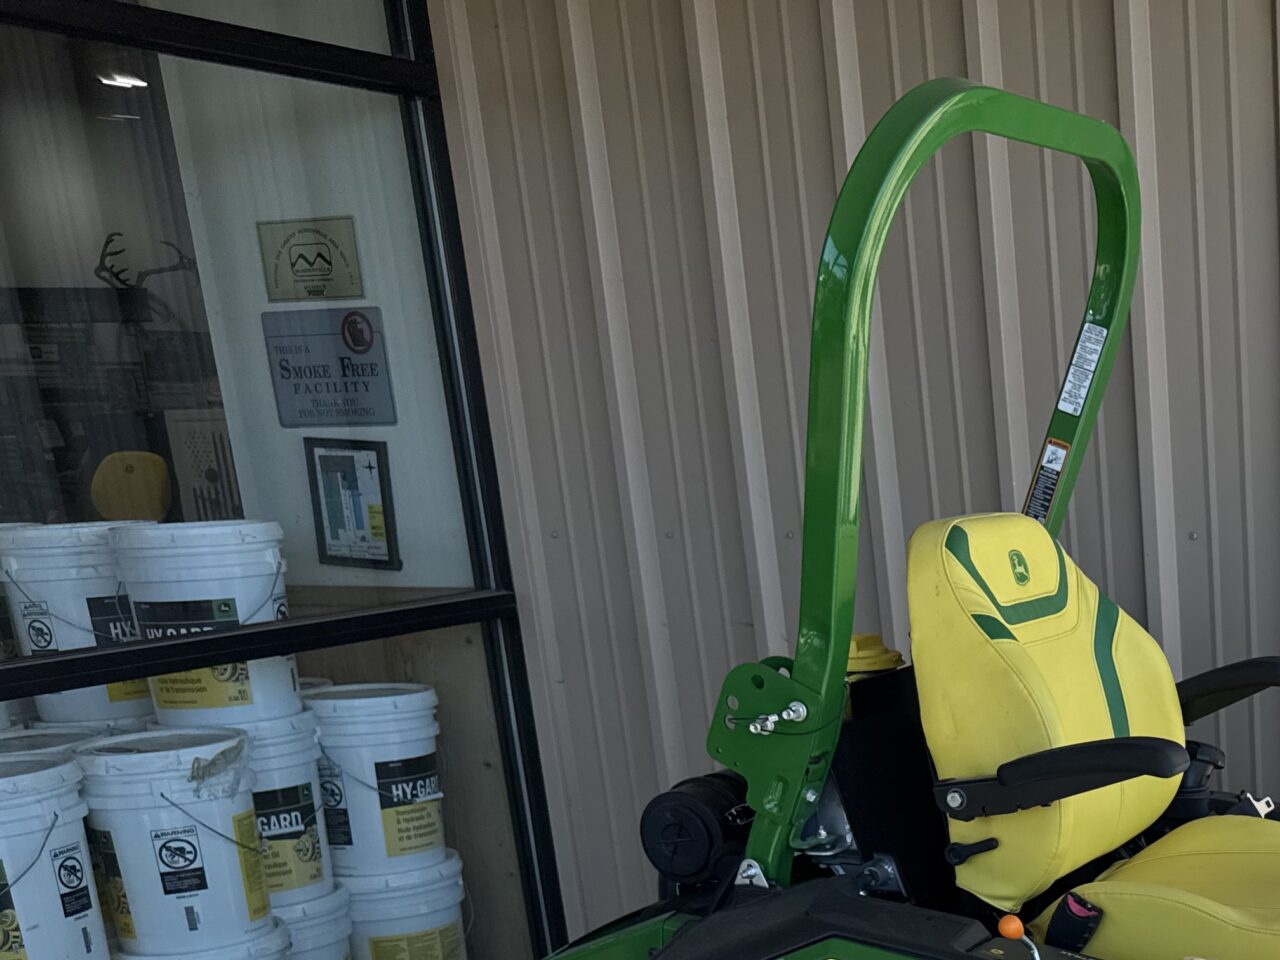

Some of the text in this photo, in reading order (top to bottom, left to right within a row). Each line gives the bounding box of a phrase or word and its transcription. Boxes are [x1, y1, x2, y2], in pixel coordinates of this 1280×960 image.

[279, 356, 379, 380] SMOKE FREE
[293, 380, 370, 394] FACILITY
